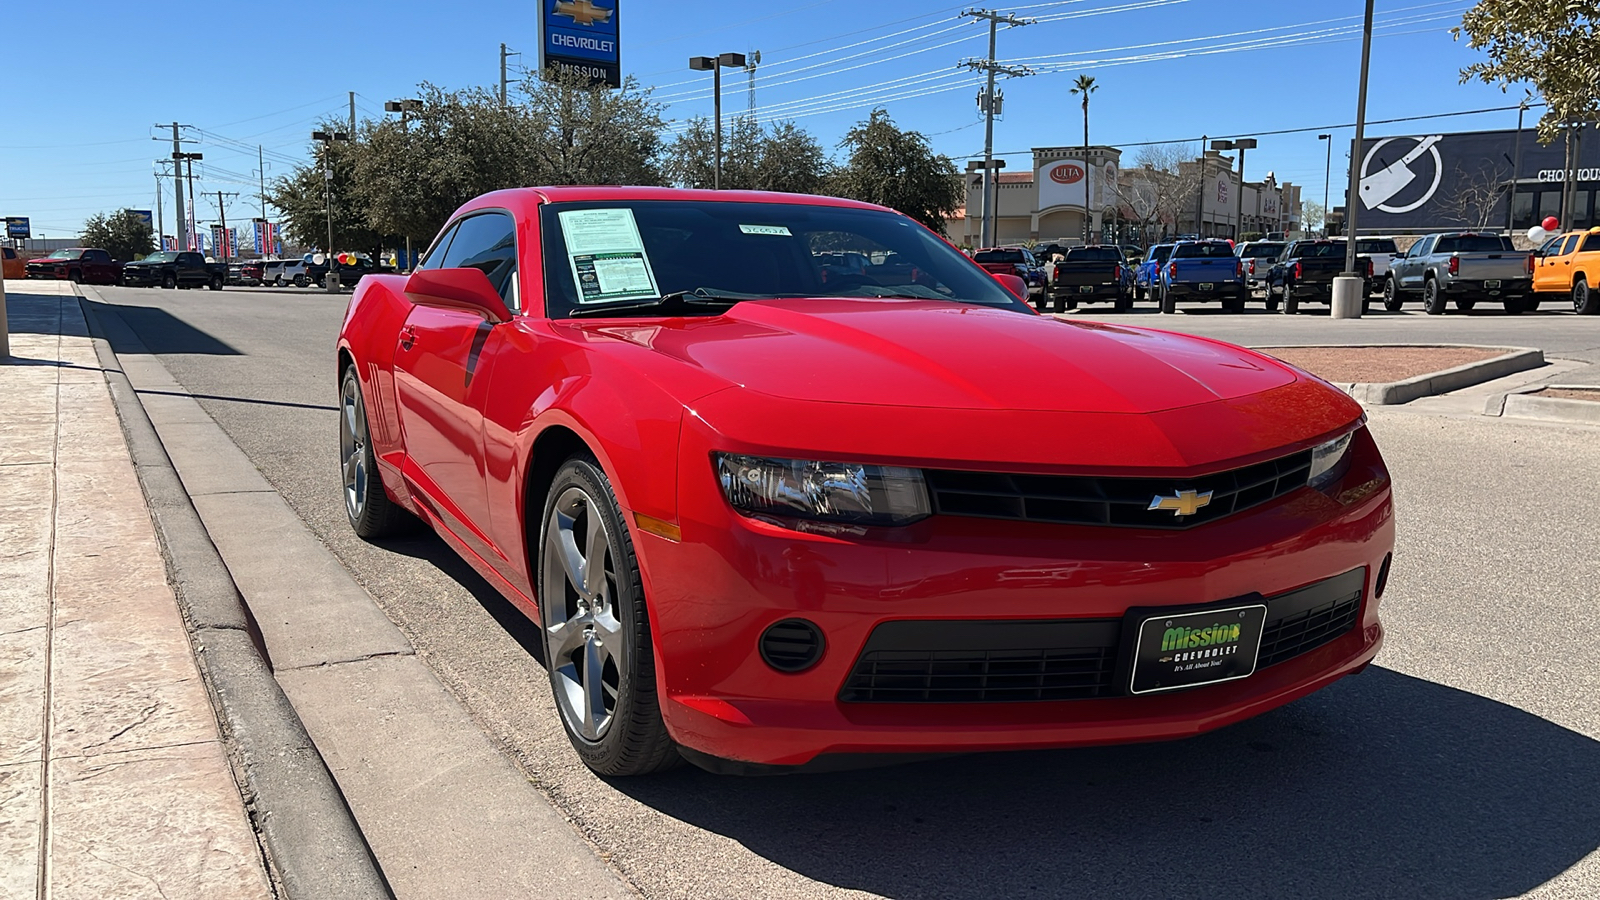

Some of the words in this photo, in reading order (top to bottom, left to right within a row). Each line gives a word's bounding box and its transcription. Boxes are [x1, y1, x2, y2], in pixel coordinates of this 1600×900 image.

[551, 33, 614, 53] CHEVROLET
[1055, 168, 1080, 177] ULTA
[1538, 168, 1600, 182] CHOPOU
[1161, 623, 1241, 651] Mission
[1174, 645, 1238, 662] CHEVROLET
[1184, 663, 1193, 671] All
[1194, 661, 1210, 669] About
[1210, 659, 1223, 667] You!
